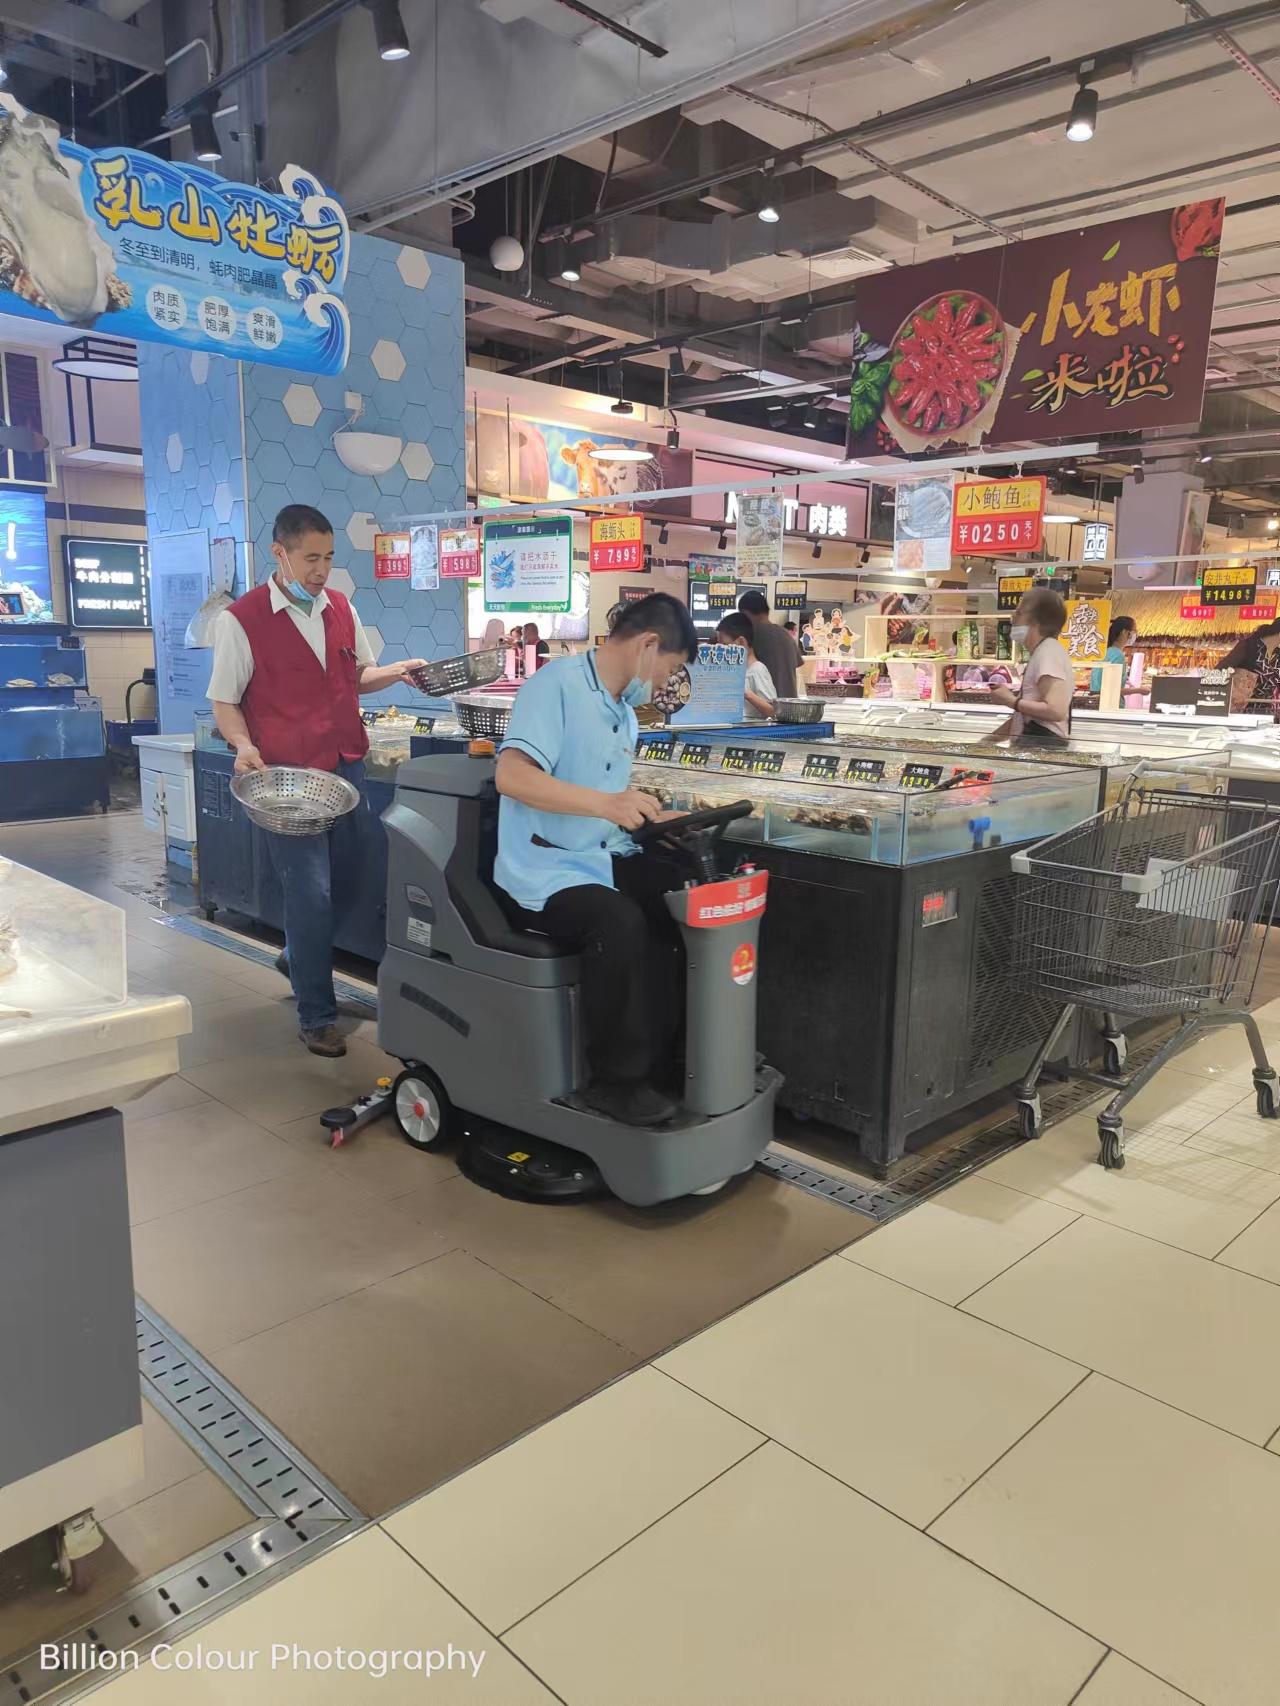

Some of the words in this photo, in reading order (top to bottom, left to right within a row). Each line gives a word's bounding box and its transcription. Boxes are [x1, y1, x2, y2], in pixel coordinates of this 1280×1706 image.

[153, 290, 180, 309] 肉质
[1020, 263, 1182, 346] 小龙虾
[153, 307, 181, 325] 紧实
[204, 301, 229, 317] 肥厚
[205, 318, 231, 335] 饱满
[252, 312, 276, 329] 爽滑
[253, 329, 277, 345] 鲜嫩
[964, 485, 1021, 511] 小鲍鱼
[809, 502, 848, 537] 肉类
